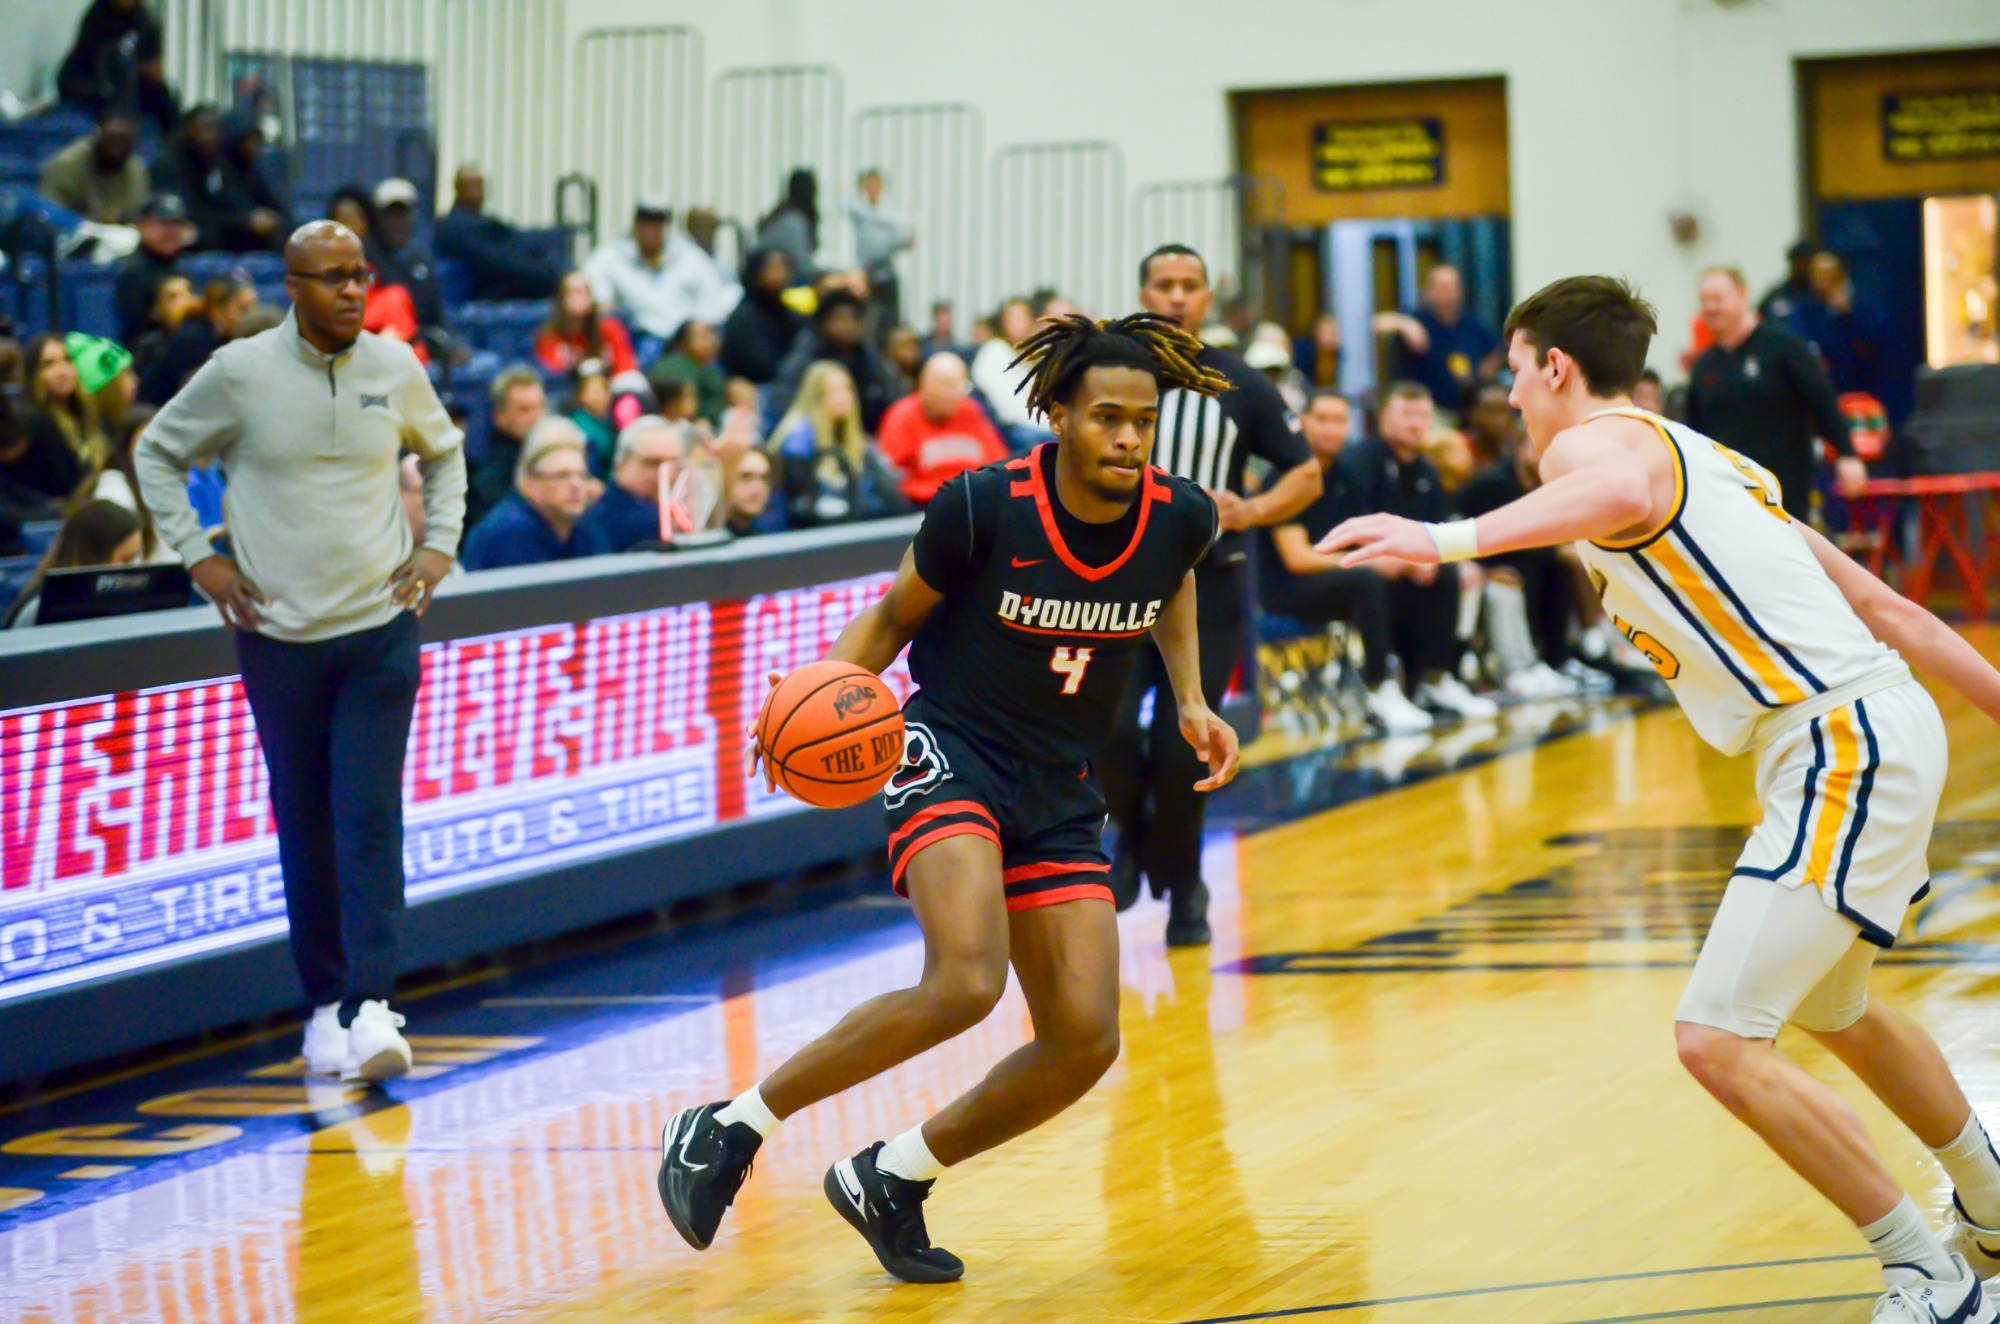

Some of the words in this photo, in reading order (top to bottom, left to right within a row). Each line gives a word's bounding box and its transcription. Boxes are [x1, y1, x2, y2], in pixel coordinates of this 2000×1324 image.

[998, 590, 1161, 631] D'YOUVILLE
[1050, 646, 1095, 694] 4
[833, 686, 877, 721] MAAC
[821, 743, 865, 775] THE
[548, 799, 582, 845] &
[599, 768, 702, 830] TIRE
[82, 903, 122, 953] &
[151, 864, 286, 933] TIRE
